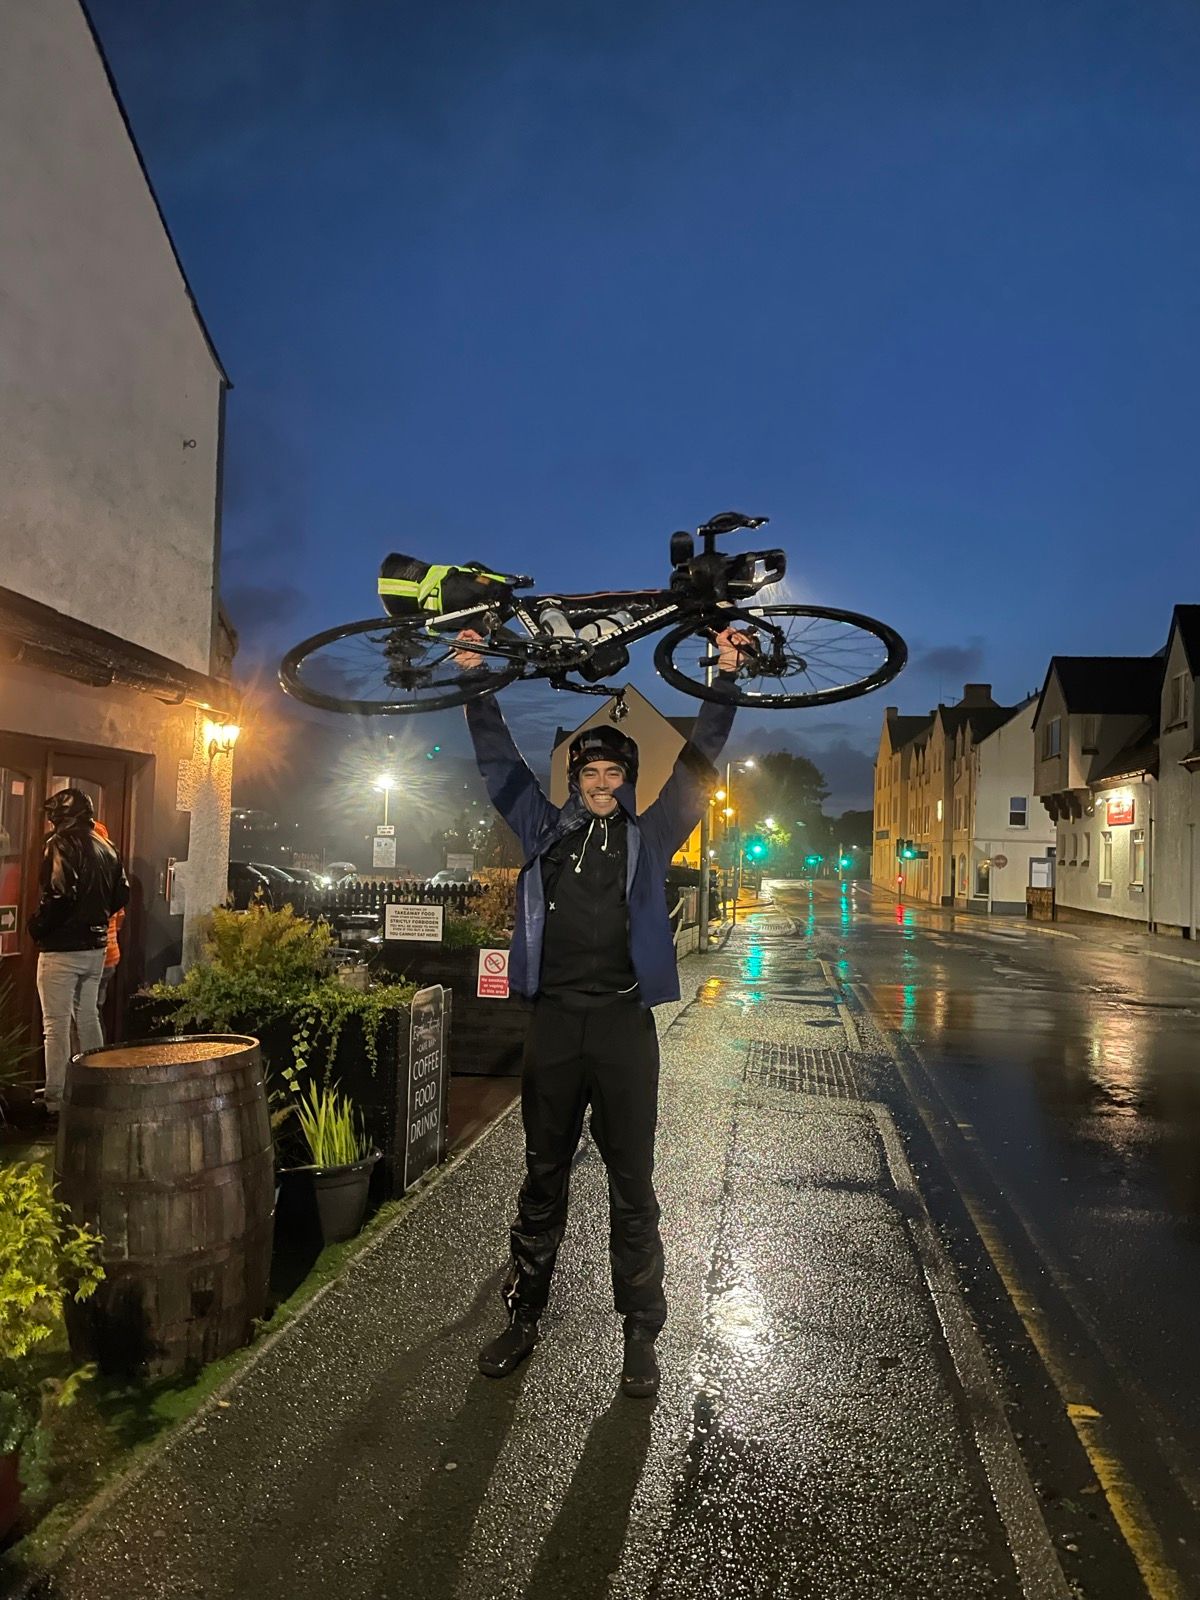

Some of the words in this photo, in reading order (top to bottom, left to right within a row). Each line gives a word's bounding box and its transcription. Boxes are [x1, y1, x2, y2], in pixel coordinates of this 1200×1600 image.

[590, 604, 678, 647] cannondale
[413, 1050, 440, 1080] COFFEE
[414, 1081, 436, 1111] FOOD
[410, 1108, 438, 1144] DRINKS
